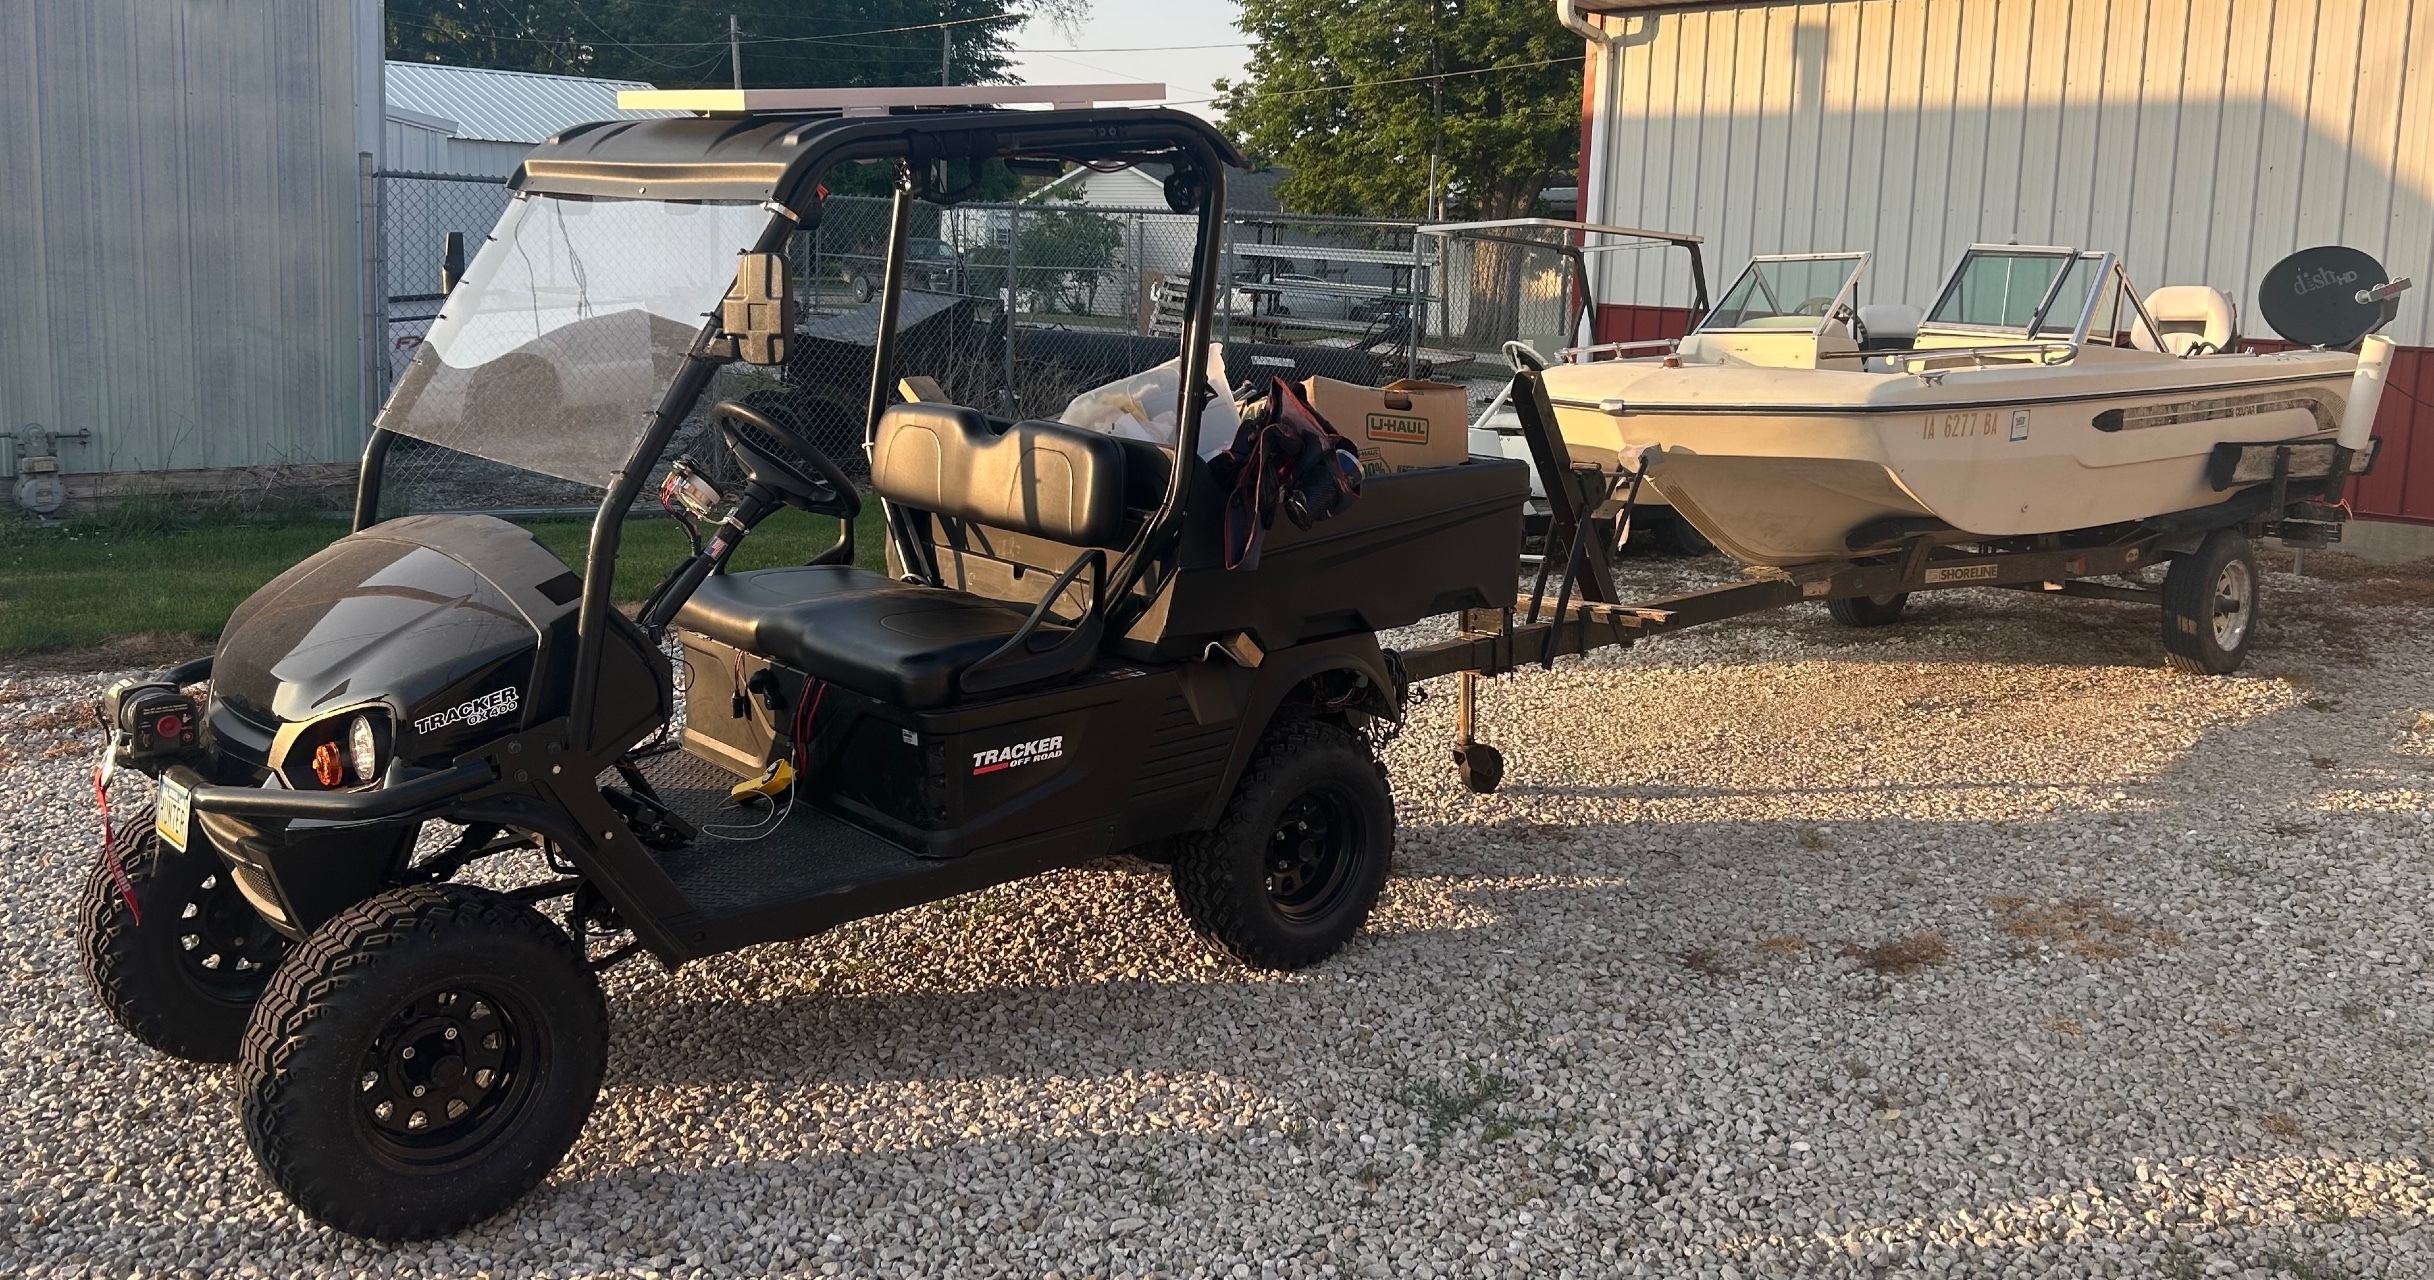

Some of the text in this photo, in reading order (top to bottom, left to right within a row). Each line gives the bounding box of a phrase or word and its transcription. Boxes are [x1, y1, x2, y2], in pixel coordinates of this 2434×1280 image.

[2294, 267, 2358, 295] dish HD
[1370, 416, 1426, 435] U-HAUL
[1923, 411, 1998, 440] IA 6277 BA
[1941, 566, 1997, 580] SHORELINE
[415, 686, 519, 734] TRACKER
[467, 700, 518, 726] OX 400
[973, 735, 1063, 767] TRACKER
[1009, 750, 1063, 768] OFF ROAD
